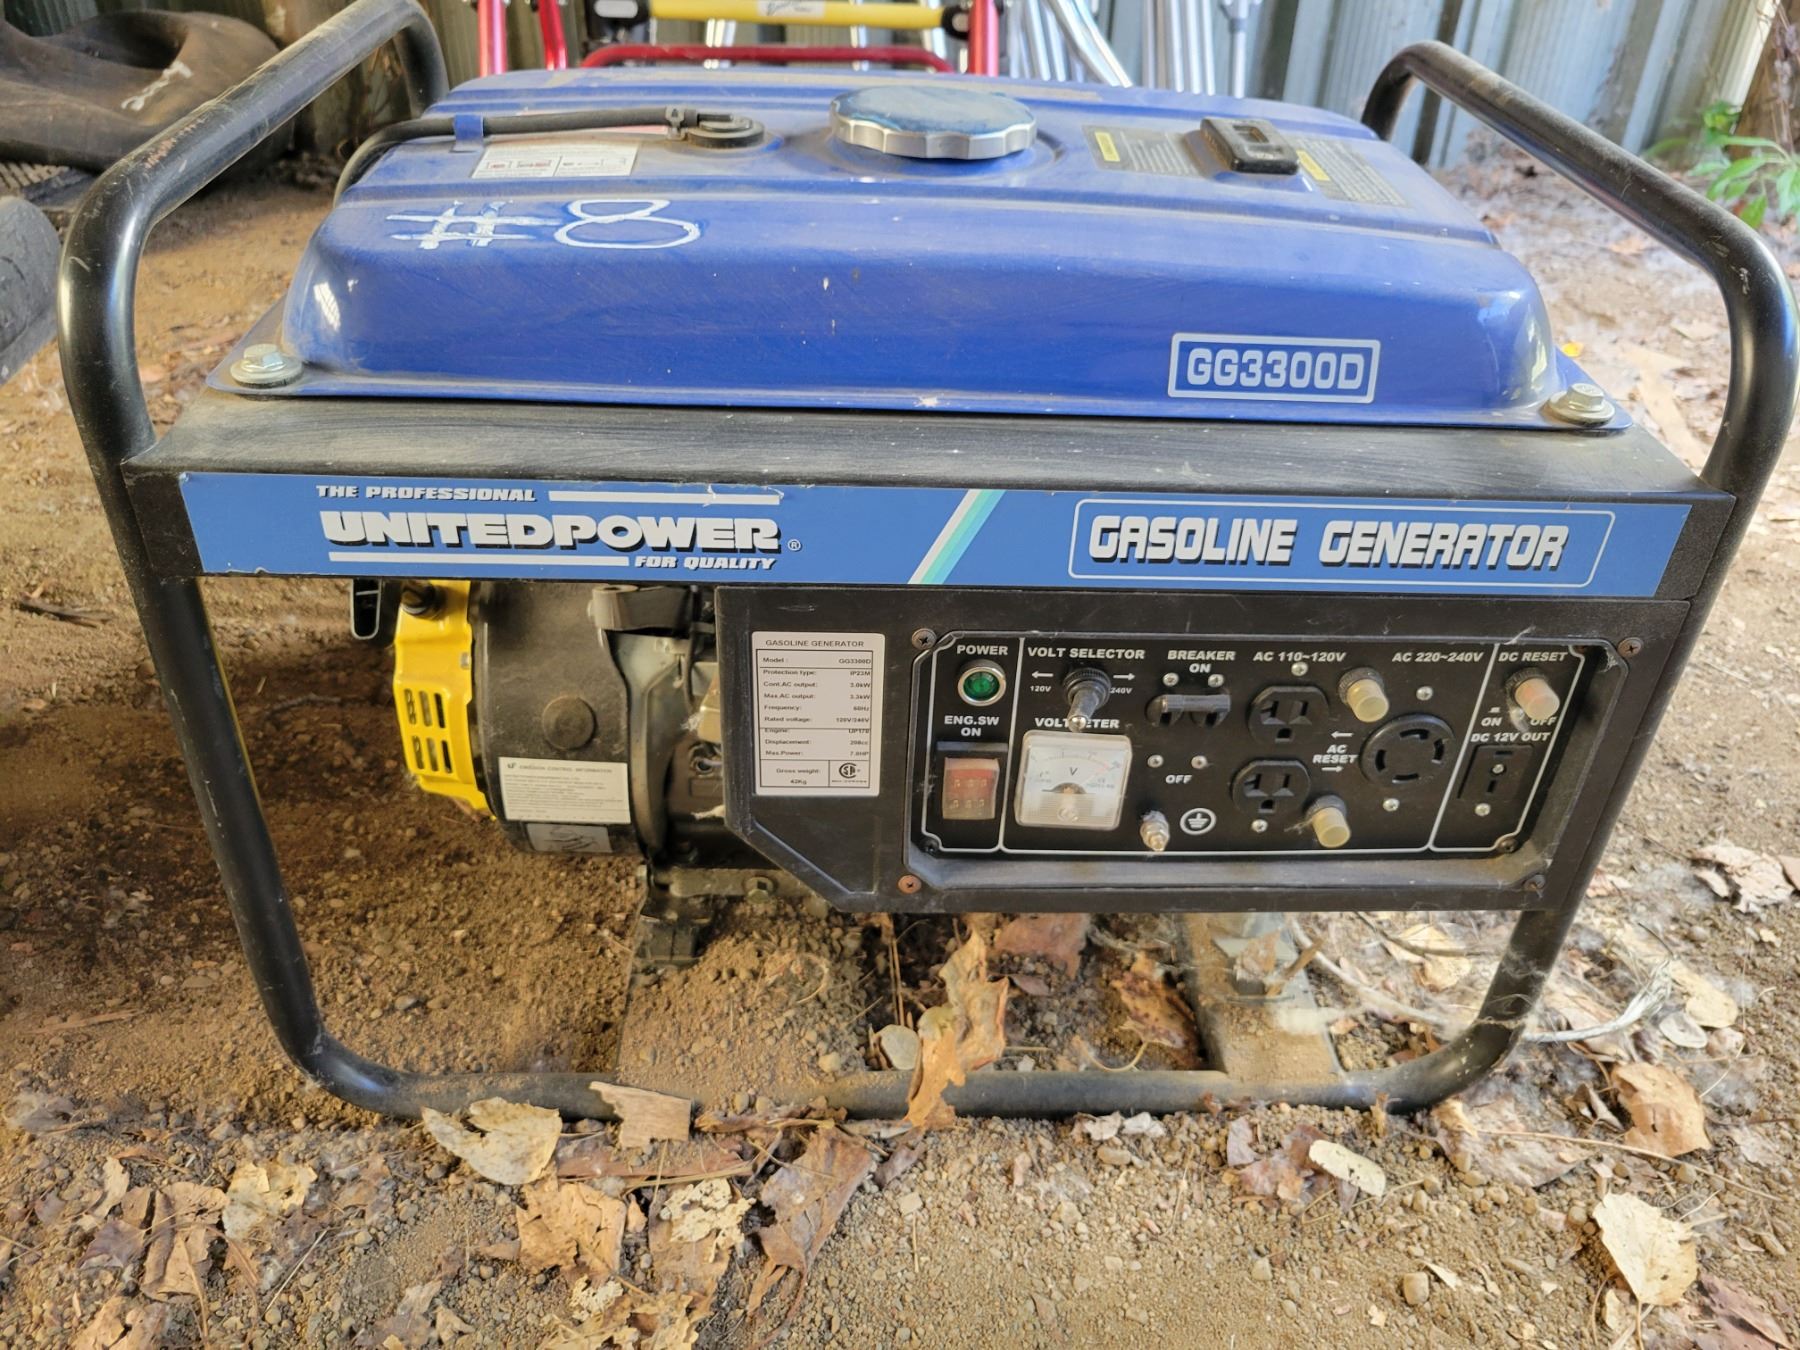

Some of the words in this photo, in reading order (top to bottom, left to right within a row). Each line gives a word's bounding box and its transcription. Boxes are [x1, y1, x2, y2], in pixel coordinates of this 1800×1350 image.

[385, 199, 701, 249] #8
[1187, 347, 1365, 390] GG3300D
[316, 485, 359, 498] THE
[365, 486, 536, 502] PROFESSIONAL
[320, 510, 781, 552] UNITEDPOWER
[1088, 515, 1298, 564] GASOLINE
[1318, 520, 1569, 570] GENERATOR
[634, 556, 680, 568] FOR
[683, 556, 777, 570] QUALITY
[765, 639, 809, 647] GASOLINE
[811, 640, 865, 648] GENERATOR
[956, 645, 1009, 656] POWER
[1028, 647, 1066, 658] VOLT
[1069, 648, 1145, 660] SELECTOR
[1167, 650, 1236, 662] BREAKER
[1253, 651, 1275, 662] AC
[1277, 651, 1346, 663] 110~120V
[1392, 651, 1414, 663] AC
[1415, 651, 1484, 663] 220~240V
[1498, 651, 1519, 662] DC
[1521, 651, 1568, 662] RESET
[1189, 663, 1211, 674] ON
[944, 715, 1000, 726] ENG.SW
[1034, 717, 1120, 728] VOLTETER
[1481, 717, 1502, 726] ON
[1530, 716, 1557, 726] OFF
[961, 727, 982, 737] ON
[1471, 733, 1490, 742] DC
[1493, 732, 1519, 742] 12V
[1521, 732, 1551, 742] OUT
[1326, 744, 1347, 754] AC
[1312, 754, 1358, 764] RESET
[1069, 767, 1078, 776] V
[1165, 774, 1193, 784] OFF
